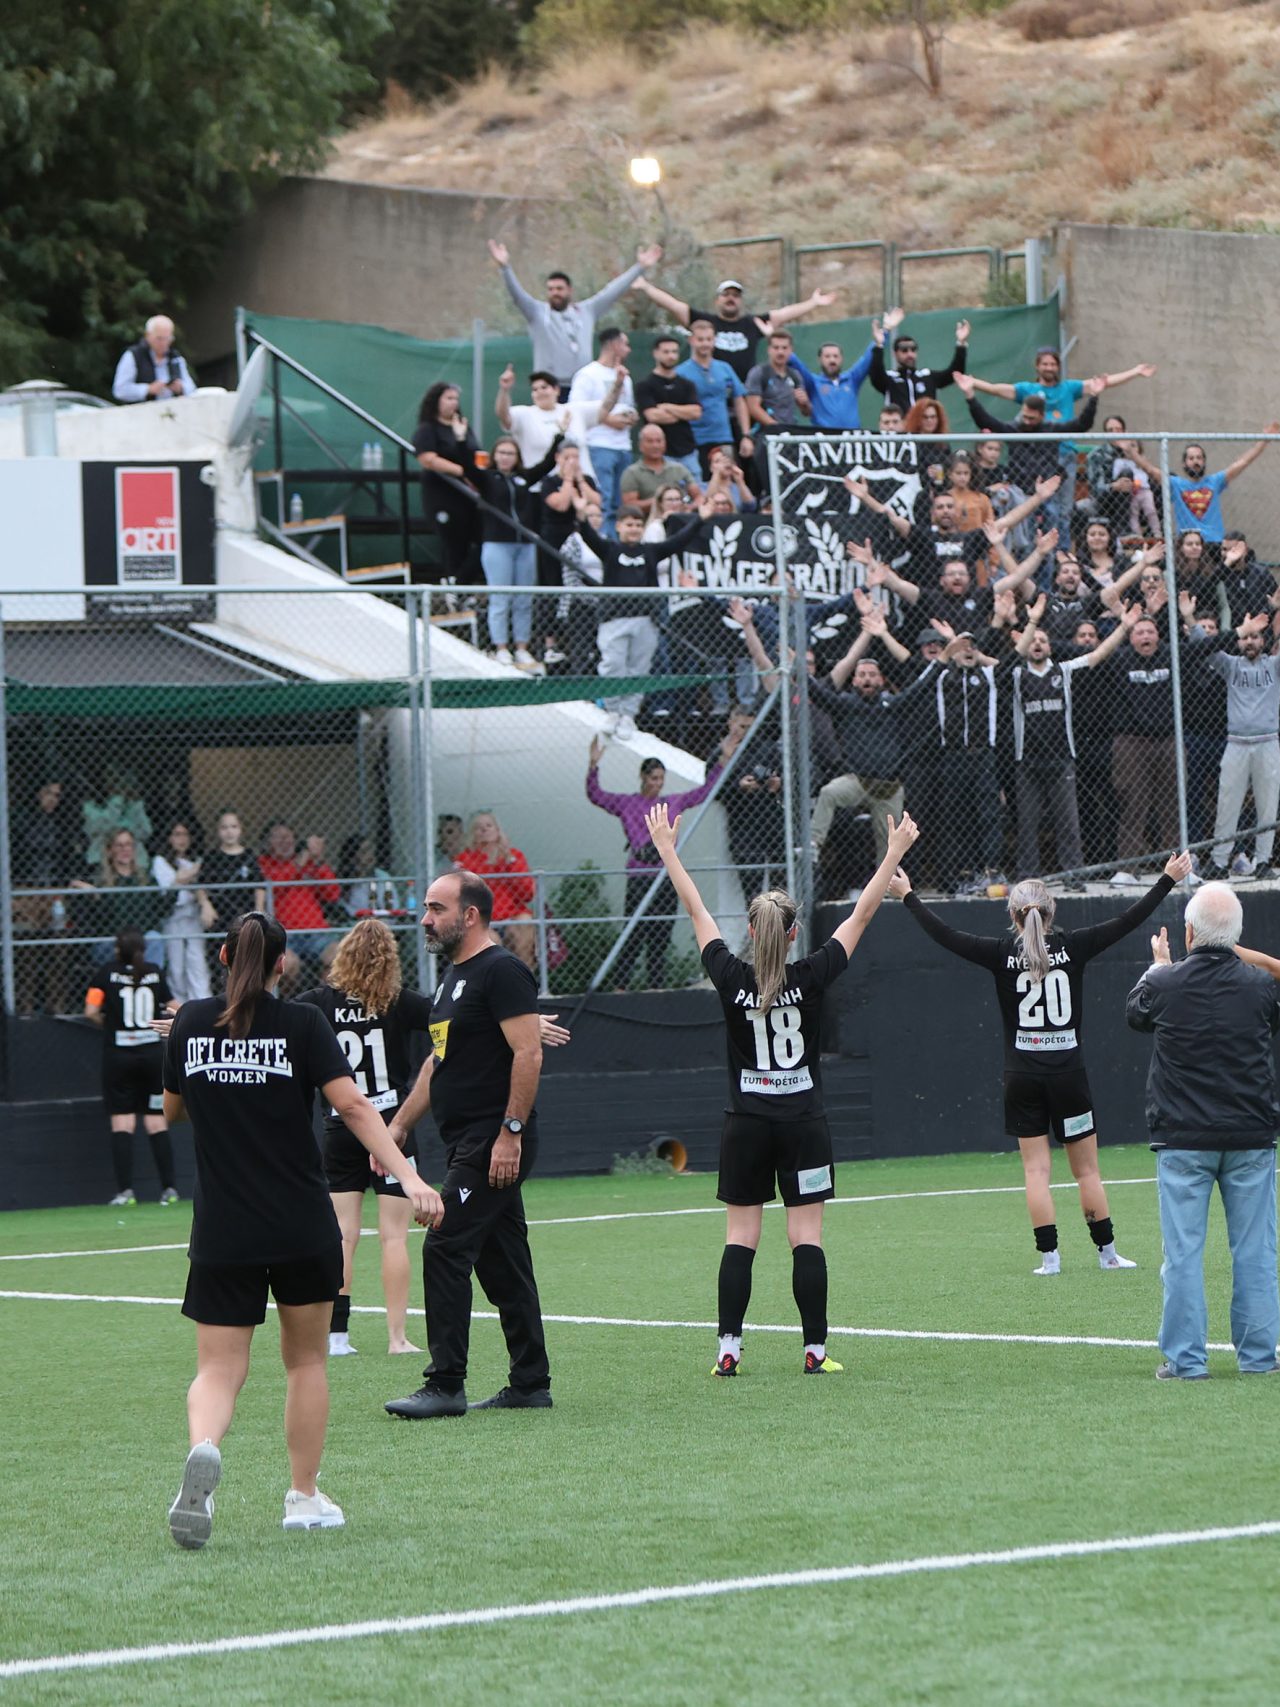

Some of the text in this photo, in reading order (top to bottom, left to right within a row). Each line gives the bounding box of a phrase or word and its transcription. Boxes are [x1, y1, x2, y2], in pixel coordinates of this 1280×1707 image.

[119, 987, 154, 1028] 10
[1016, 969, 1072, 1027] 20
[187, 1037, 288, 1069] OFI CRETE
[335, 1028, 390, 1096] 21
[745, 1005, 805, 1071] 18
[206, 1069, 268, 1084] WOMEN
